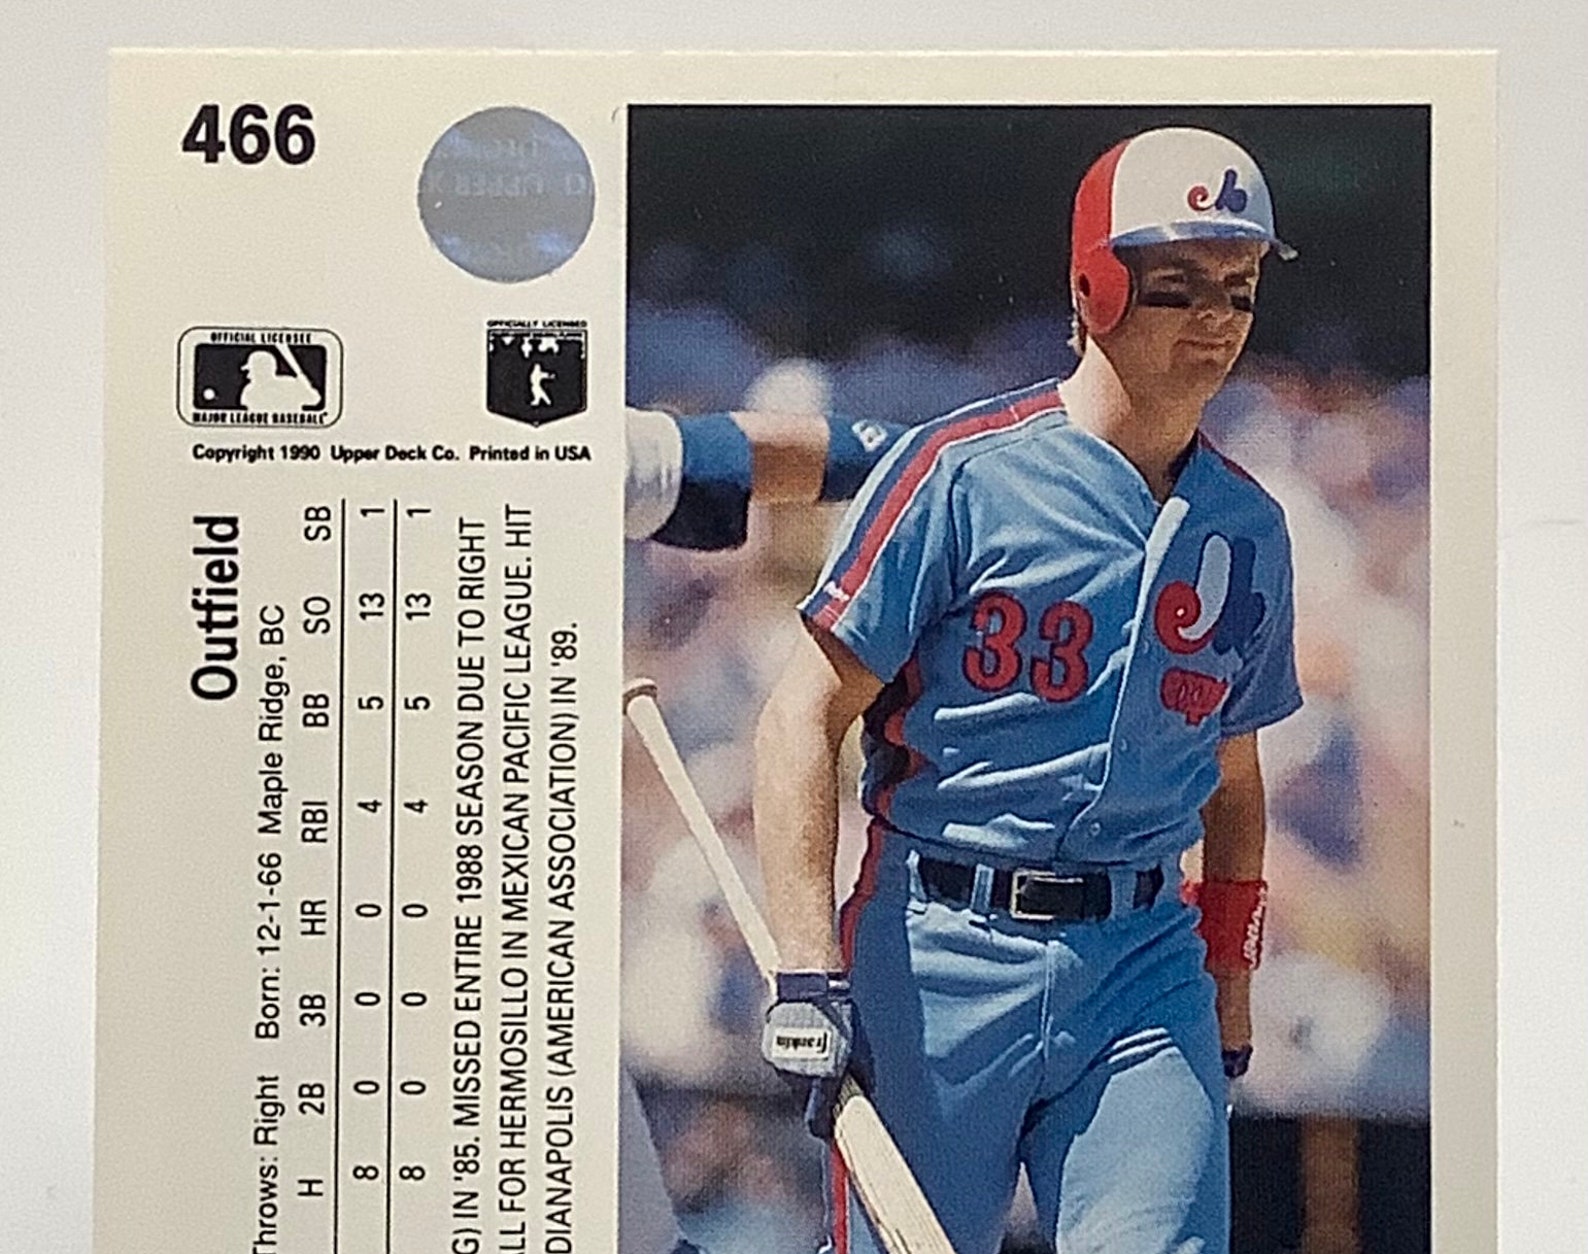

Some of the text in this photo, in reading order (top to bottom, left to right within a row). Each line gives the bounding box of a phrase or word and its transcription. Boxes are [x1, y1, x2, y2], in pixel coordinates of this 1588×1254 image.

[181, 103, 317, 166] 466
[210, 331, 312, 344] OFFICIAL LICENSEE
[192, 412, 227, 424] MAJOR
[230, 412, 269, 425] LEAGUE
[191, 443, 592, 464] Copyright 1990 Upper Deck Co. Printed in USA
[303, 505, 333, 542] SB
[359, 507, 386, 519] 1
[405, 507, 433, 519] 1
[503, 502, 533, 548] HIT
[457, 515, 487, 601] RIGHT
[189, 514, 241, 702] Outfield
[258, 604, 286, 646] BC
[301, 595, 332, 636] SO
[357, 591, 386, 622] 13
[403, 592, 432, 622] 13
[502, 555, 533, 674] LEAGUE.
[456, 608, 486, 649] TO
[549, 622, 578, 668] '89.
[961, 587, 1095, 703] 33
[257, 655, 291, 743] Ridge,
[356, 695, 385, 711] 5
[403, 695, 432, 712] 5
[456, 655, 486, 713] DUE
[548, 675, 578, 705] IN
[301, 692, 331, 729] BB
[501, 681, 532, 784] PACIFIC
[256, 751, 290, 836] Maple
[454, 720, 485, 837] SEASON
[299, 800, 329, 844] RBI
[355, 798, 384, 815] 4
[402, 798, 430, 815] 4
[546, 712, 581, 912] ASSOCIATION)
[454, 843, 484, 904] 1988
[500, 792, 531, 922] MEXICAN
[255, 851, 283, 957] 12-1-66
[299, 898, 328, 937] HR
[354, 902, 383, 919] 0
[400, 902, 429, 919] 0
[453, 914, 483, 1012] ENTIRE
[500, 930, 530, 960] IN
[254, 965, 282, 1040] Born:
[297, 993, 327, 1029] 3B
[353, 991, 382, 1007] 0
[399, 991, 428, 1008] 0
[545, 919, 578, 1078] (AMERICAN
[451, 1019, 482, 1128] MISSED
[498, 966, 529, 1150] HERMOSILLO
[296, 1082, 326, 1117] 2B
[352, 1079, 381, 1097] 0
[398, 1079, 428, 1096] 0
[252, 1074, 287, 1147] Right
[351, 1164, 380, 1182] 8
[397, 1164, 427, 1182] 8
[452, 1135, 481, 1183] '85.
[295, 1178, 325, 1198] H
[451, 1190, 480, 1220] IN
[497, 1157, 528, 1213] FOR
